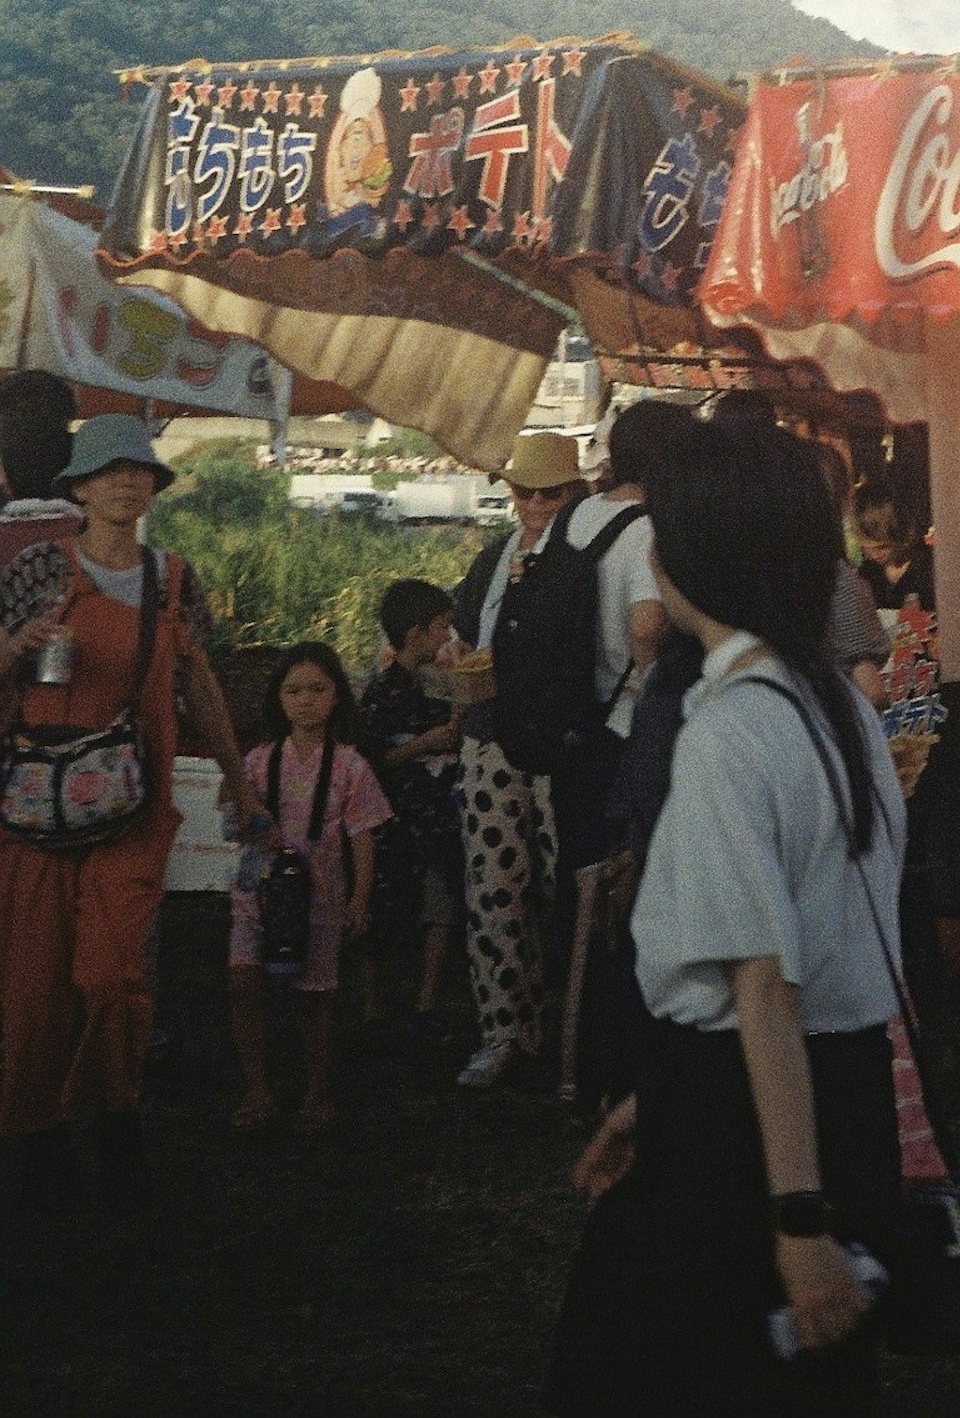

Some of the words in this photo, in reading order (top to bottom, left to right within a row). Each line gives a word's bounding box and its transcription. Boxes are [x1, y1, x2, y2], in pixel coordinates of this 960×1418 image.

[165, 95, 318, 236] もちもち
[402, 78, 573, 224] ポテト
